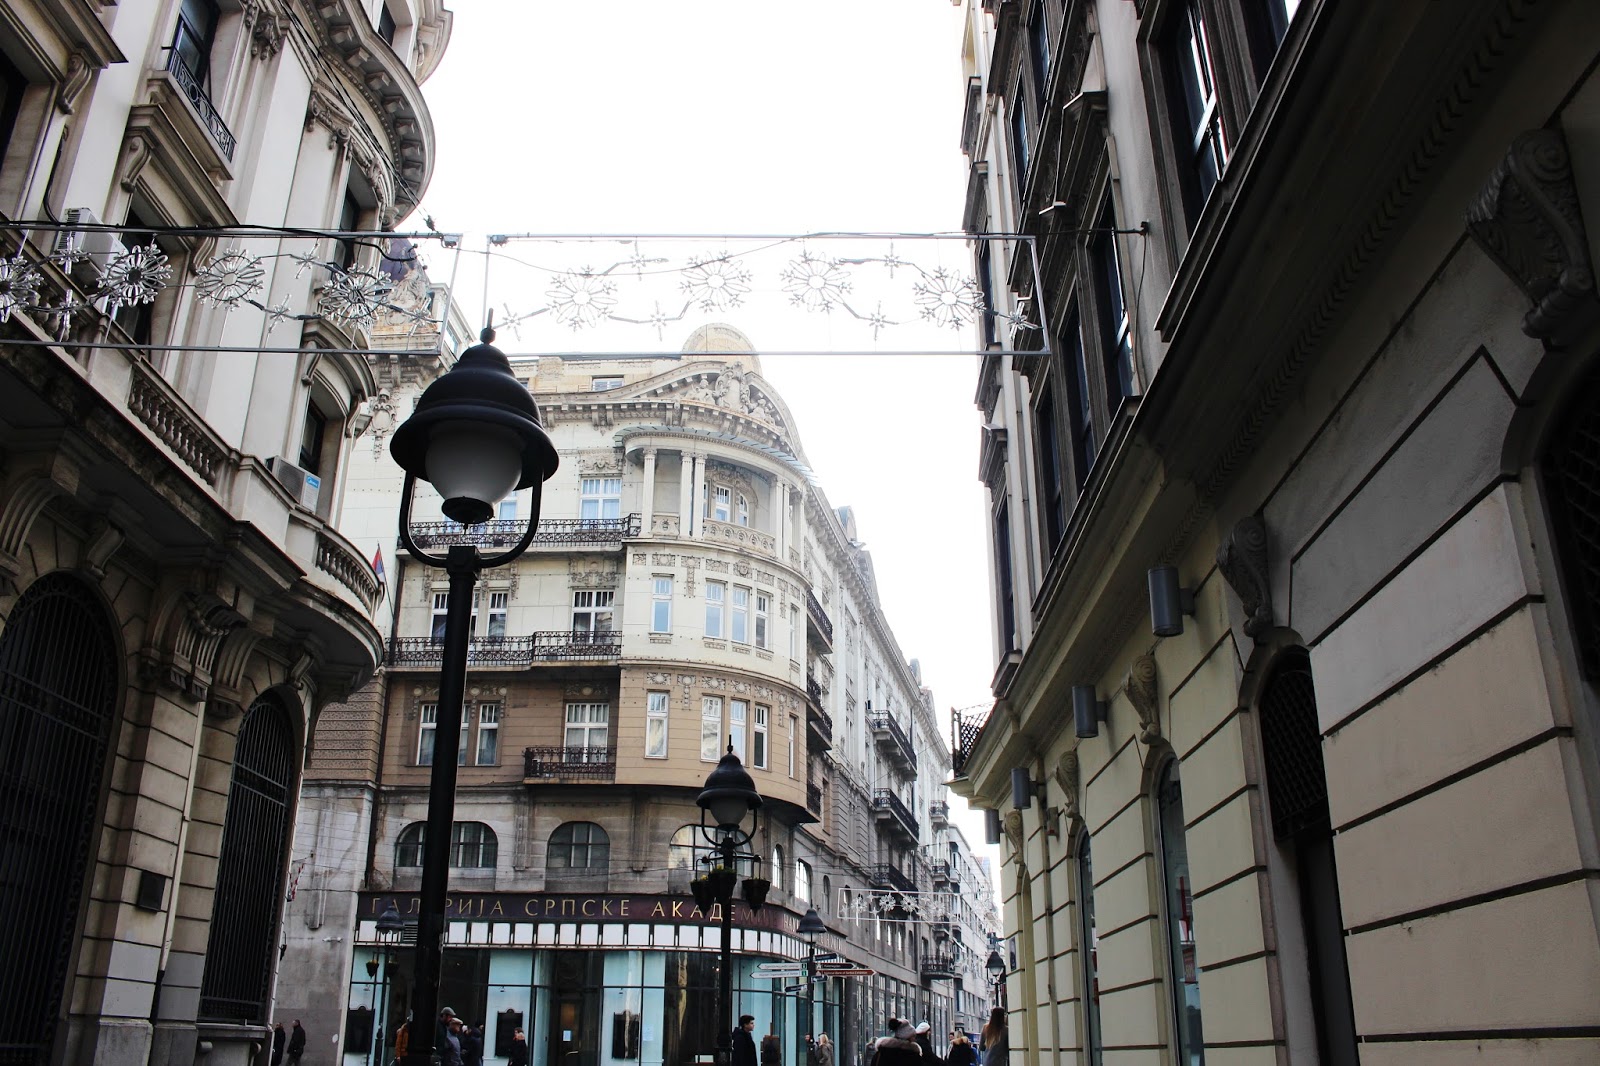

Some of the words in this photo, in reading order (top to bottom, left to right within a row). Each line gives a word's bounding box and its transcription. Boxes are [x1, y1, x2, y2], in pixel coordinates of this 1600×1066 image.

[371, 897, 504, 917] ГАЛРИЈА
[524, 899, 630, 916] СРПСКЕ
[651, 900, 775, 924] АКАДЕМИ
